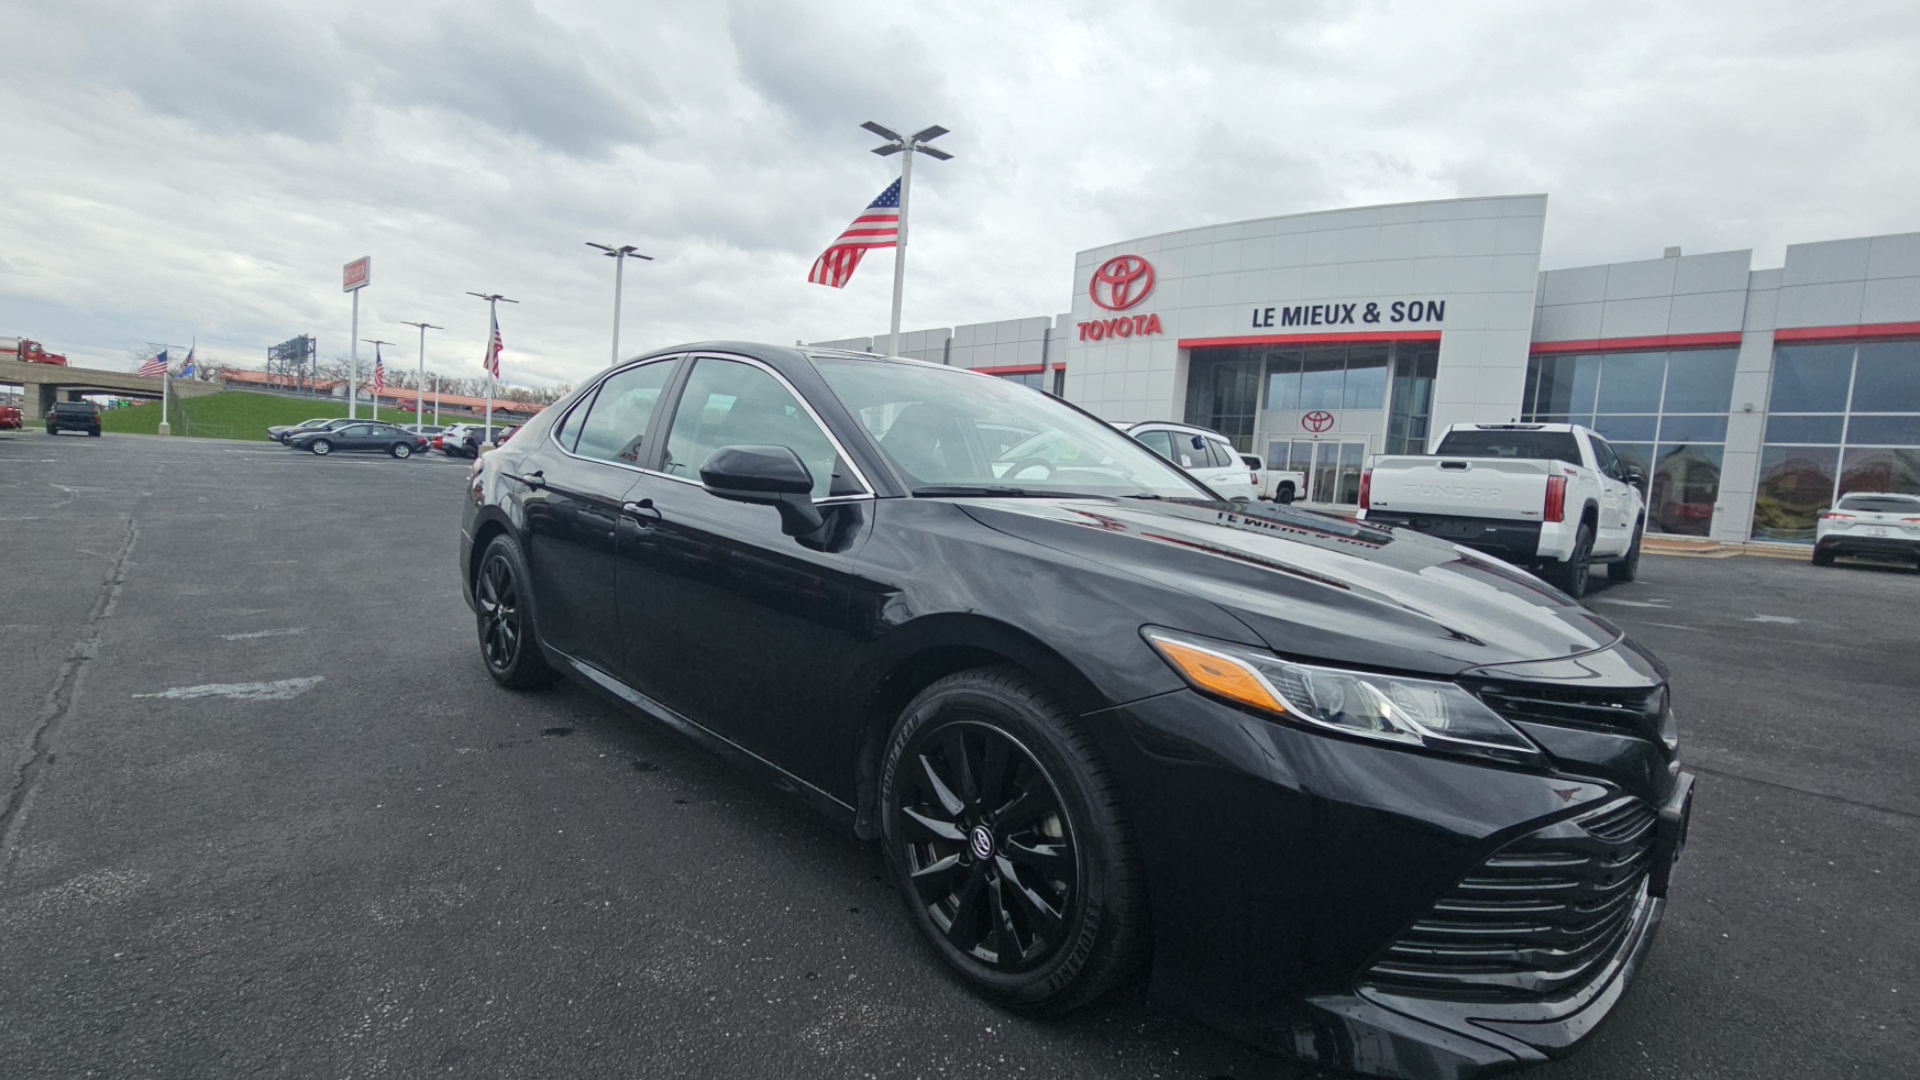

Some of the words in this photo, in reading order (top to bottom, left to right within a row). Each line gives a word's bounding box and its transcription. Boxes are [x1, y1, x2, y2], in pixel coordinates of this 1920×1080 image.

[1077, 313, 1163, 342] TOYOTA
[1252, 307, 1276, 328] LE
[1281, 303, 1357, 327] MIEUX
[1362, 302, 1381, 323] &
[1390, 300, 1446, 323] SON
[1402, 483, 1503, 500] TUNDRA
